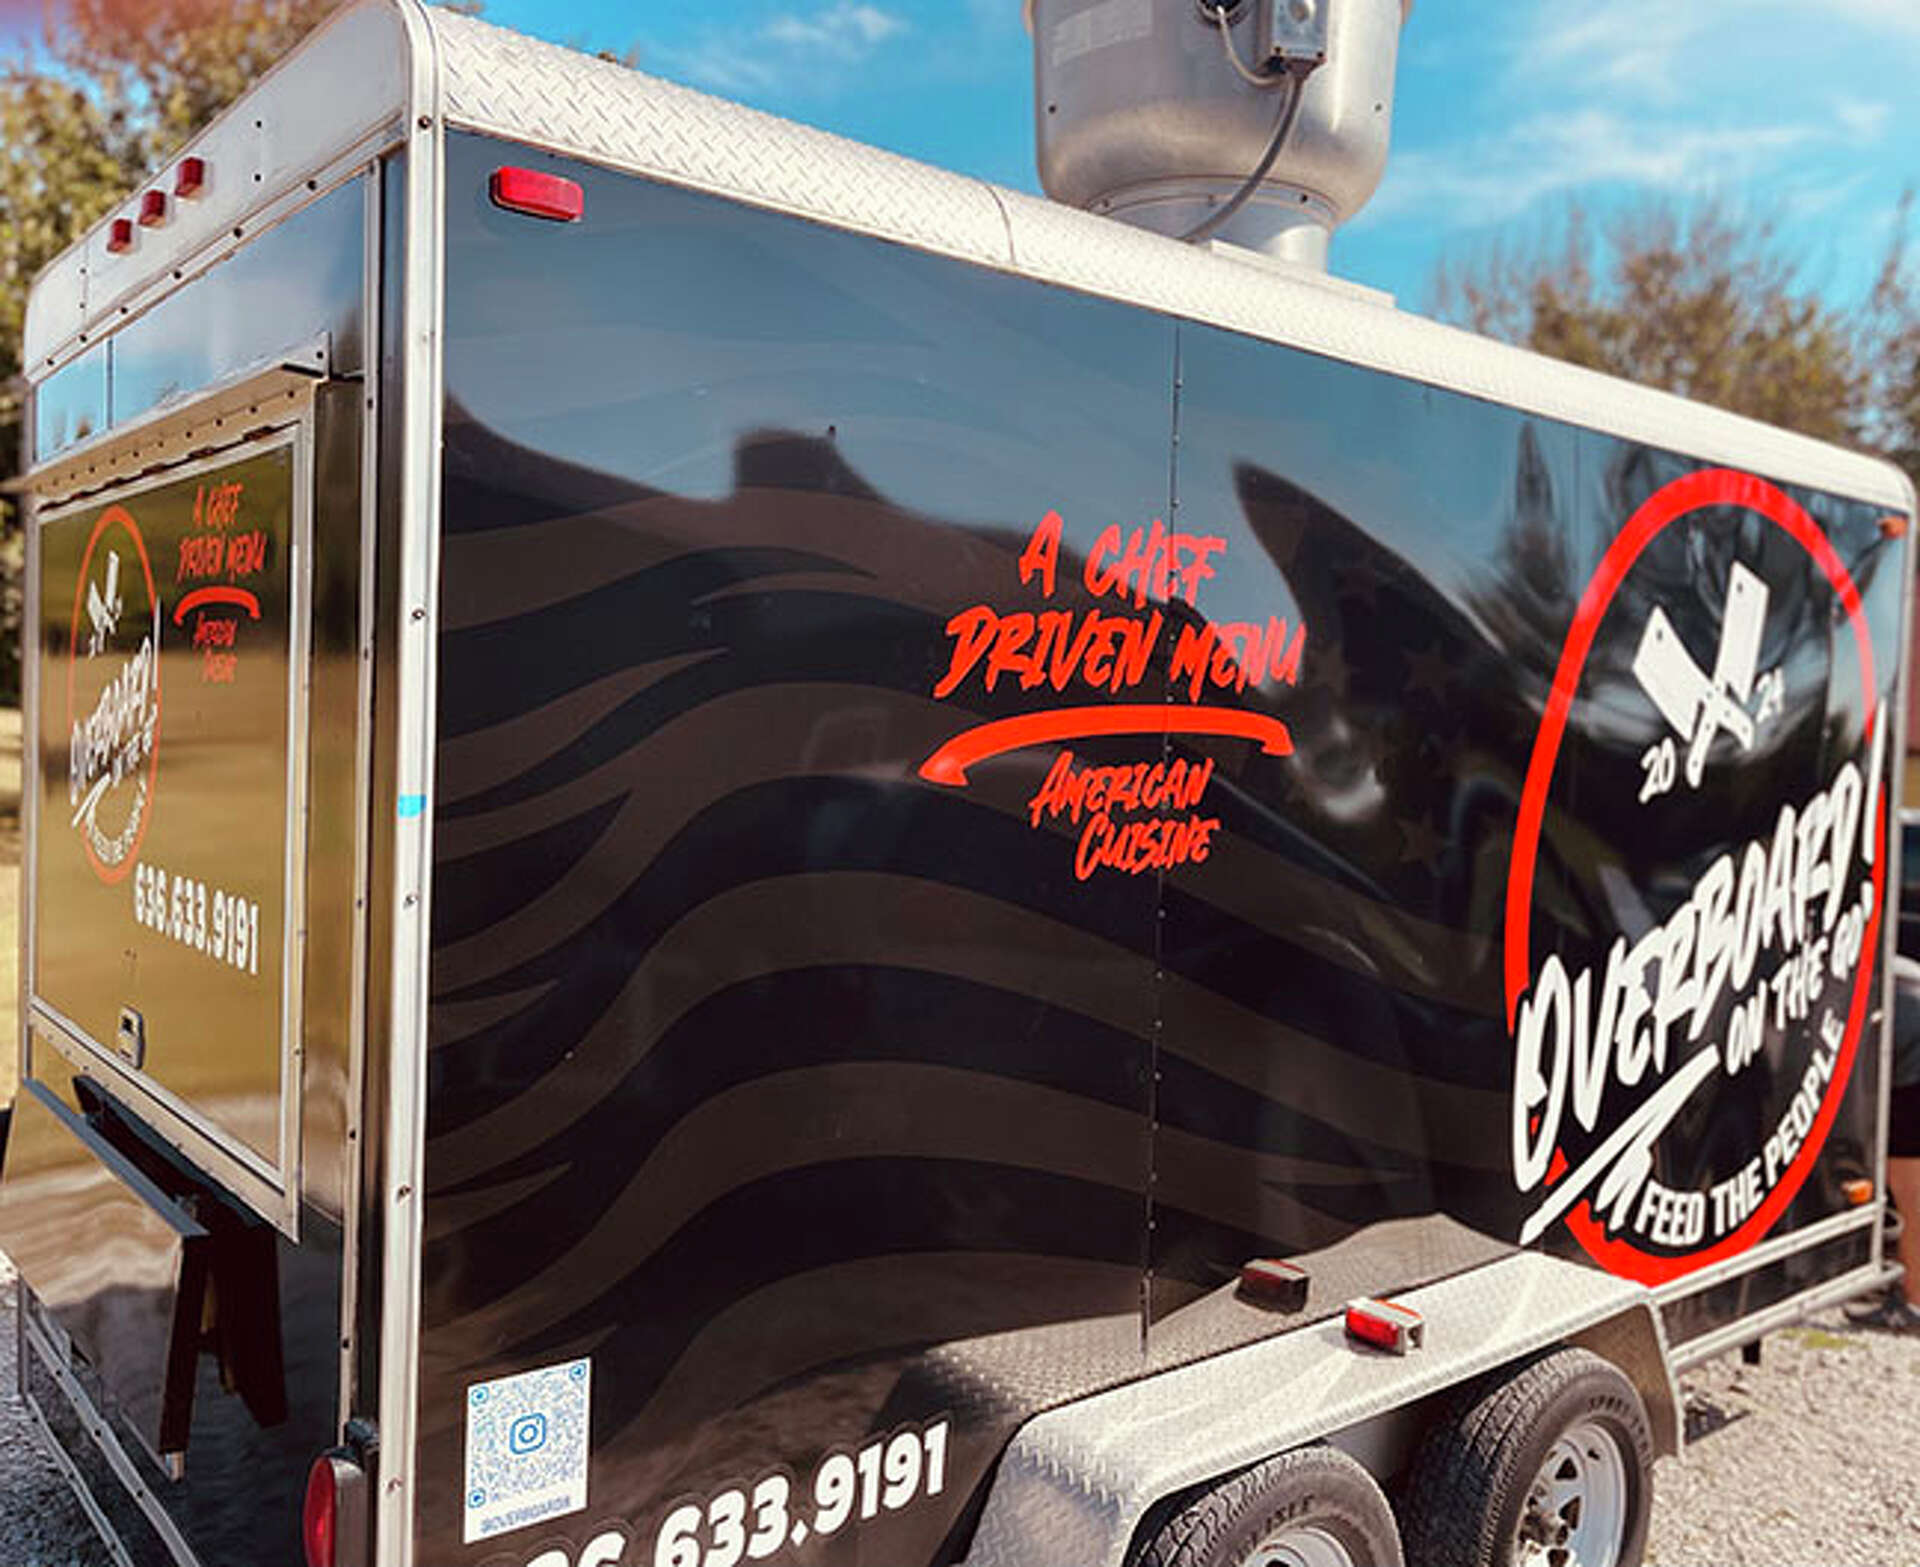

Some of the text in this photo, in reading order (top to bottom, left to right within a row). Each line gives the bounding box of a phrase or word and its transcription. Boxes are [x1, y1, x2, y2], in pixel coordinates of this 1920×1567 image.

[1018, 510, 1227, 610] A CHEF
[933, 605, 1306, 703] DRIVEN MENU
[1029, 751, 1214, 828] AMERICAN
[1639, 737, 1676, 803] 20
[1075, 812, 1220, 881] CUISINE
[1727, 979, 1767, 1076] ON
[1771, 936, 1828, 1031] THE
[1634, 1008, 1846, 1247] FEED THE PEOPLE
